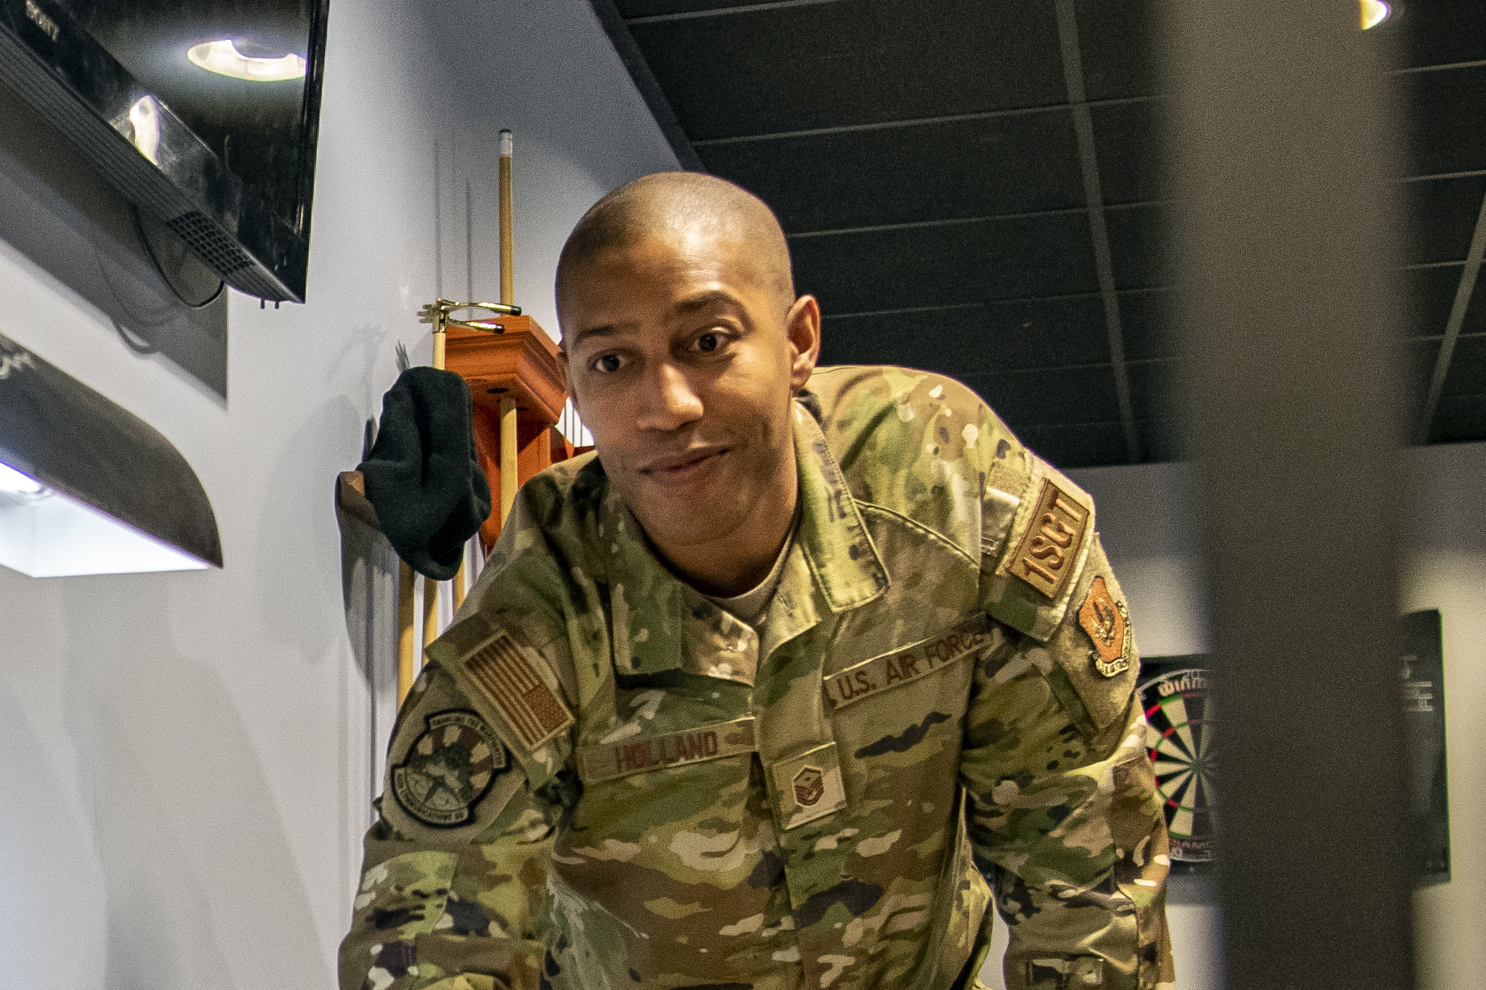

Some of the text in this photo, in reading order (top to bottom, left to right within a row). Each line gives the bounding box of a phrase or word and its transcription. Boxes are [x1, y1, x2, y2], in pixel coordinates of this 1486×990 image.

[1022, 489, 1083, 585] 1SGT
[837, 623, 984, 700] U.S. AIR FORCE
[615, 730, 718, 773] HOLLAND
